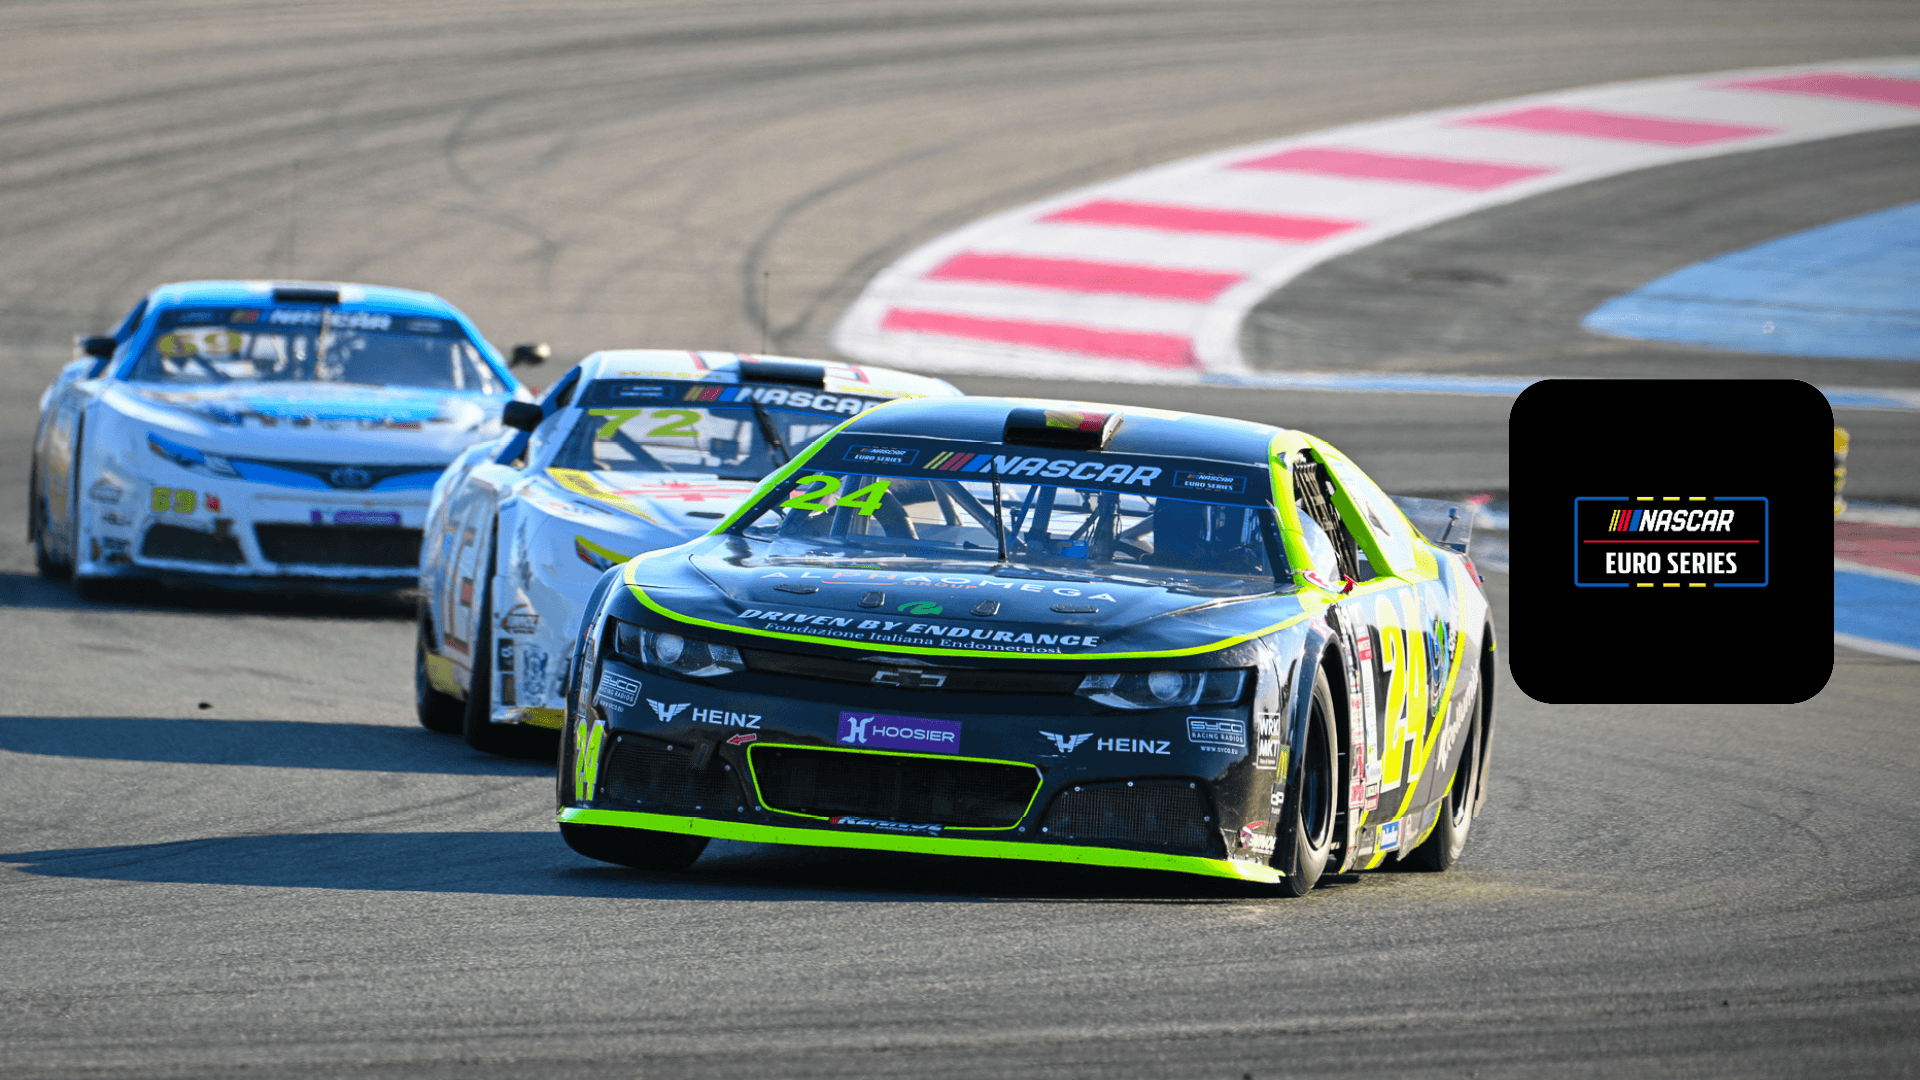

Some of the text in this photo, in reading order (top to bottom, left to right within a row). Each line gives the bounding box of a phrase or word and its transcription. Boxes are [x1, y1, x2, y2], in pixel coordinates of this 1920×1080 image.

[588, 408, 702, 438] 72
[854, 454, 903, 464] EURO SERIES
[979, 454, 1162, 487] NASCAR
[1198, 474, 1234, 483] NASCAR
[1184, 480, 1234, 491] EURO SERIES
[780, 474, 891, 516] 24
[737, 609, 1099, 648] DRIVEN BY ENDURANCE
[764, 622, 1062, 654] Fondazione Italiana Endometriosi
[602, 675, 638, 693] SYCO
[1376, 588, 1428, 794] 24
[692, 708, 762, 729] HEINZ
[1191, 721, 1243, 733] SYCO
[1259, 719, 1279, 736] WRK
[872, 725, 955, 744] HOOSIER
[1192, 731, 1244, 743] RACING RADIOS
[1097, 737, 1171, 755] HEINZ
[1259, 739, 1280, 757] MKT
[576, 719, 606, 801] 24
